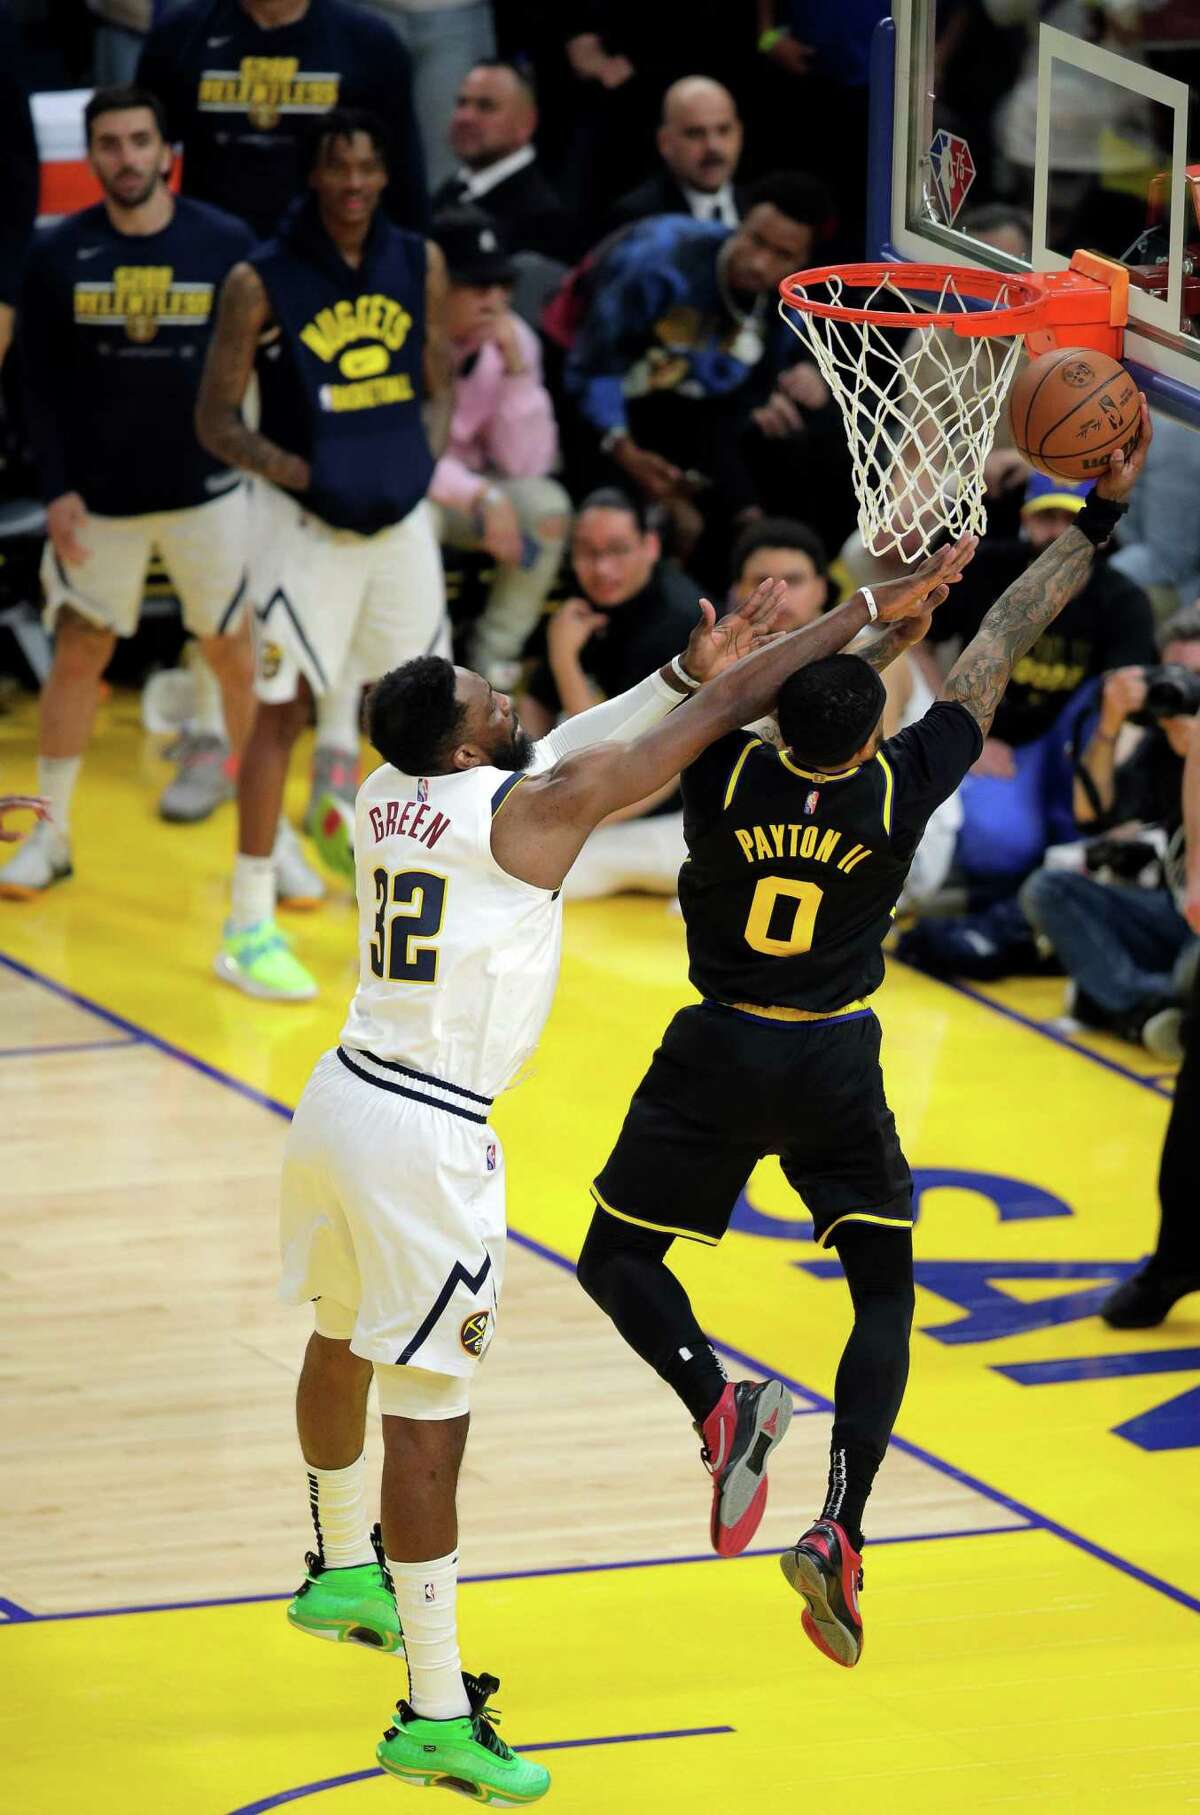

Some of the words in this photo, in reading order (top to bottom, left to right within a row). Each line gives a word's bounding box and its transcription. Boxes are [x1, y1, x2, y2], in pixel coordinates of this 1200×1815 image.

[300, 294, 412, 362] NUGGETS
[369, 801, 451, 849] GREEN
[735, 824, 842, 863] PAYTON
[368, 865, 449, 985] 32
[744, 876, 824, 957] 0
